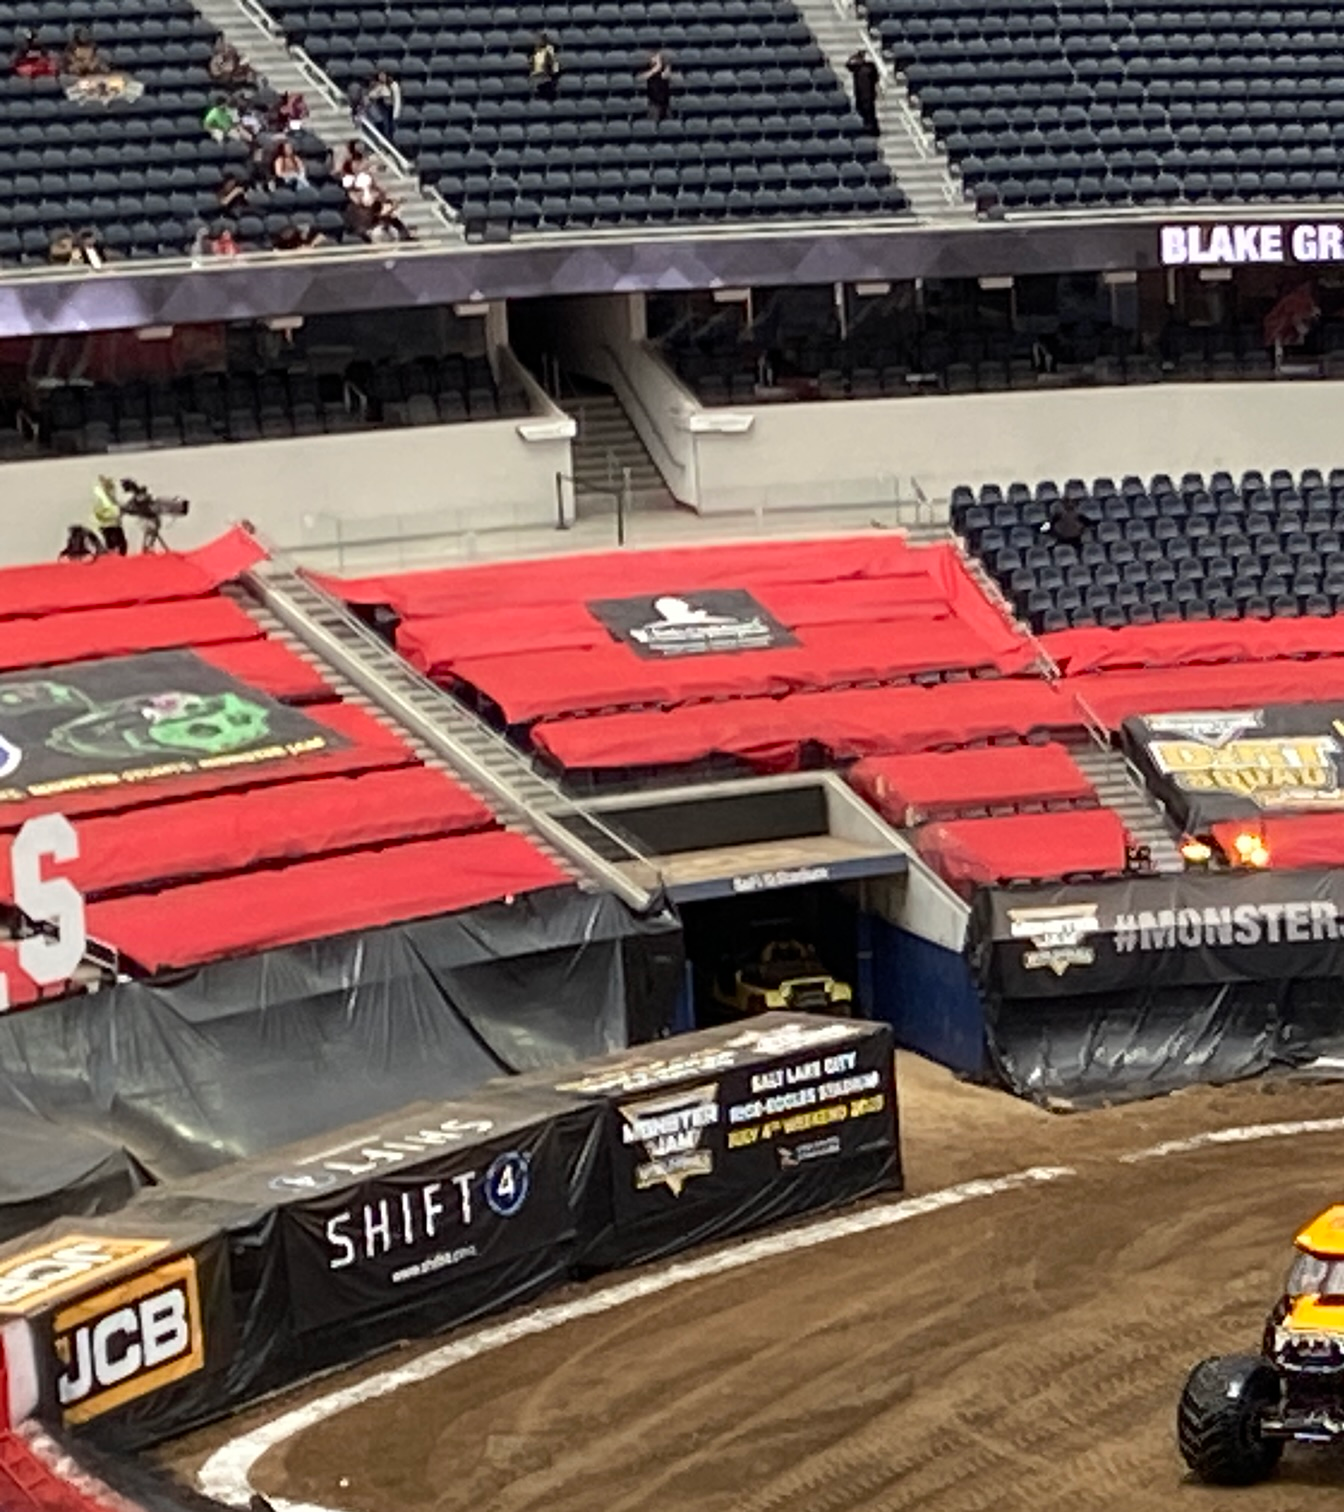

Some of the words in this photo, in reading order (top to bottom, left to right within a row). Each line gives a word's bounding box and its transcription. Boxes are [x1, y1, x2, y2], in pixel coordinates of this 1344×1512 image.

[1160, 224, 1284, 264] BLAKE
[325, 1170, 477, 1269] SHIFT
[496, 1163, 516, 1199] 4
[58, 1287, 189, 1405] JCB
